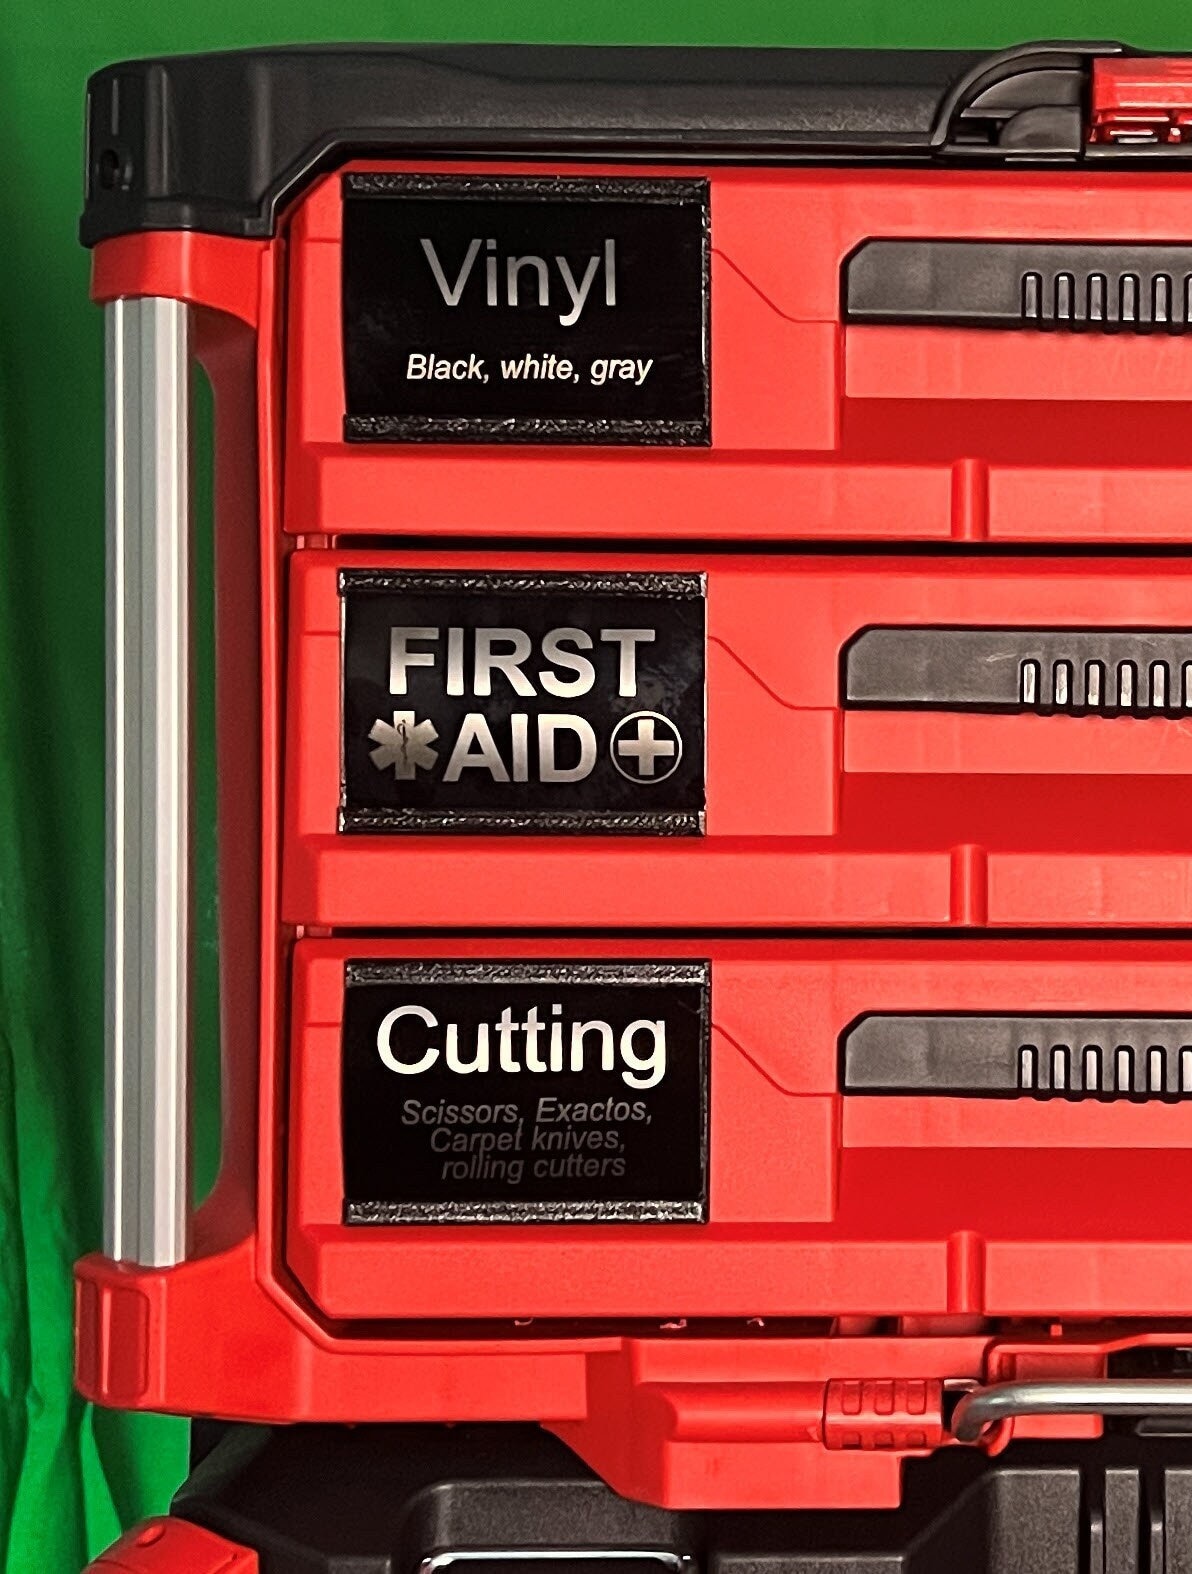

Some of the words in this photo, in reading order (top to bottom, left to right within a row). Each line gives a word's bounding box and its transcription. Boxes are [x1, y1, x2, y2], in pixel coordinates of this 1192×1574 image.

[421, 239, 616, 326] Vinyl
[406, 354, 489, 384] Black,
[501, 354, 580, 384] white,
[590, 358, 653, 385] gray
[389, 627, 656, 698] FIRST
[443, 713, 597, 782] AID
[376, 1004, 667, 1089] Cutting
[401, 1099, 524, 1125] Scissors,
[535, 1097, 652, 1125] Exactos,
[430, 1126, 522, 1155] Carpet
[531, 1125, 625, 1153] knives,
[441, 1154, 524, 1184] rolling
[533, 1153, 626, 1178] cutters
